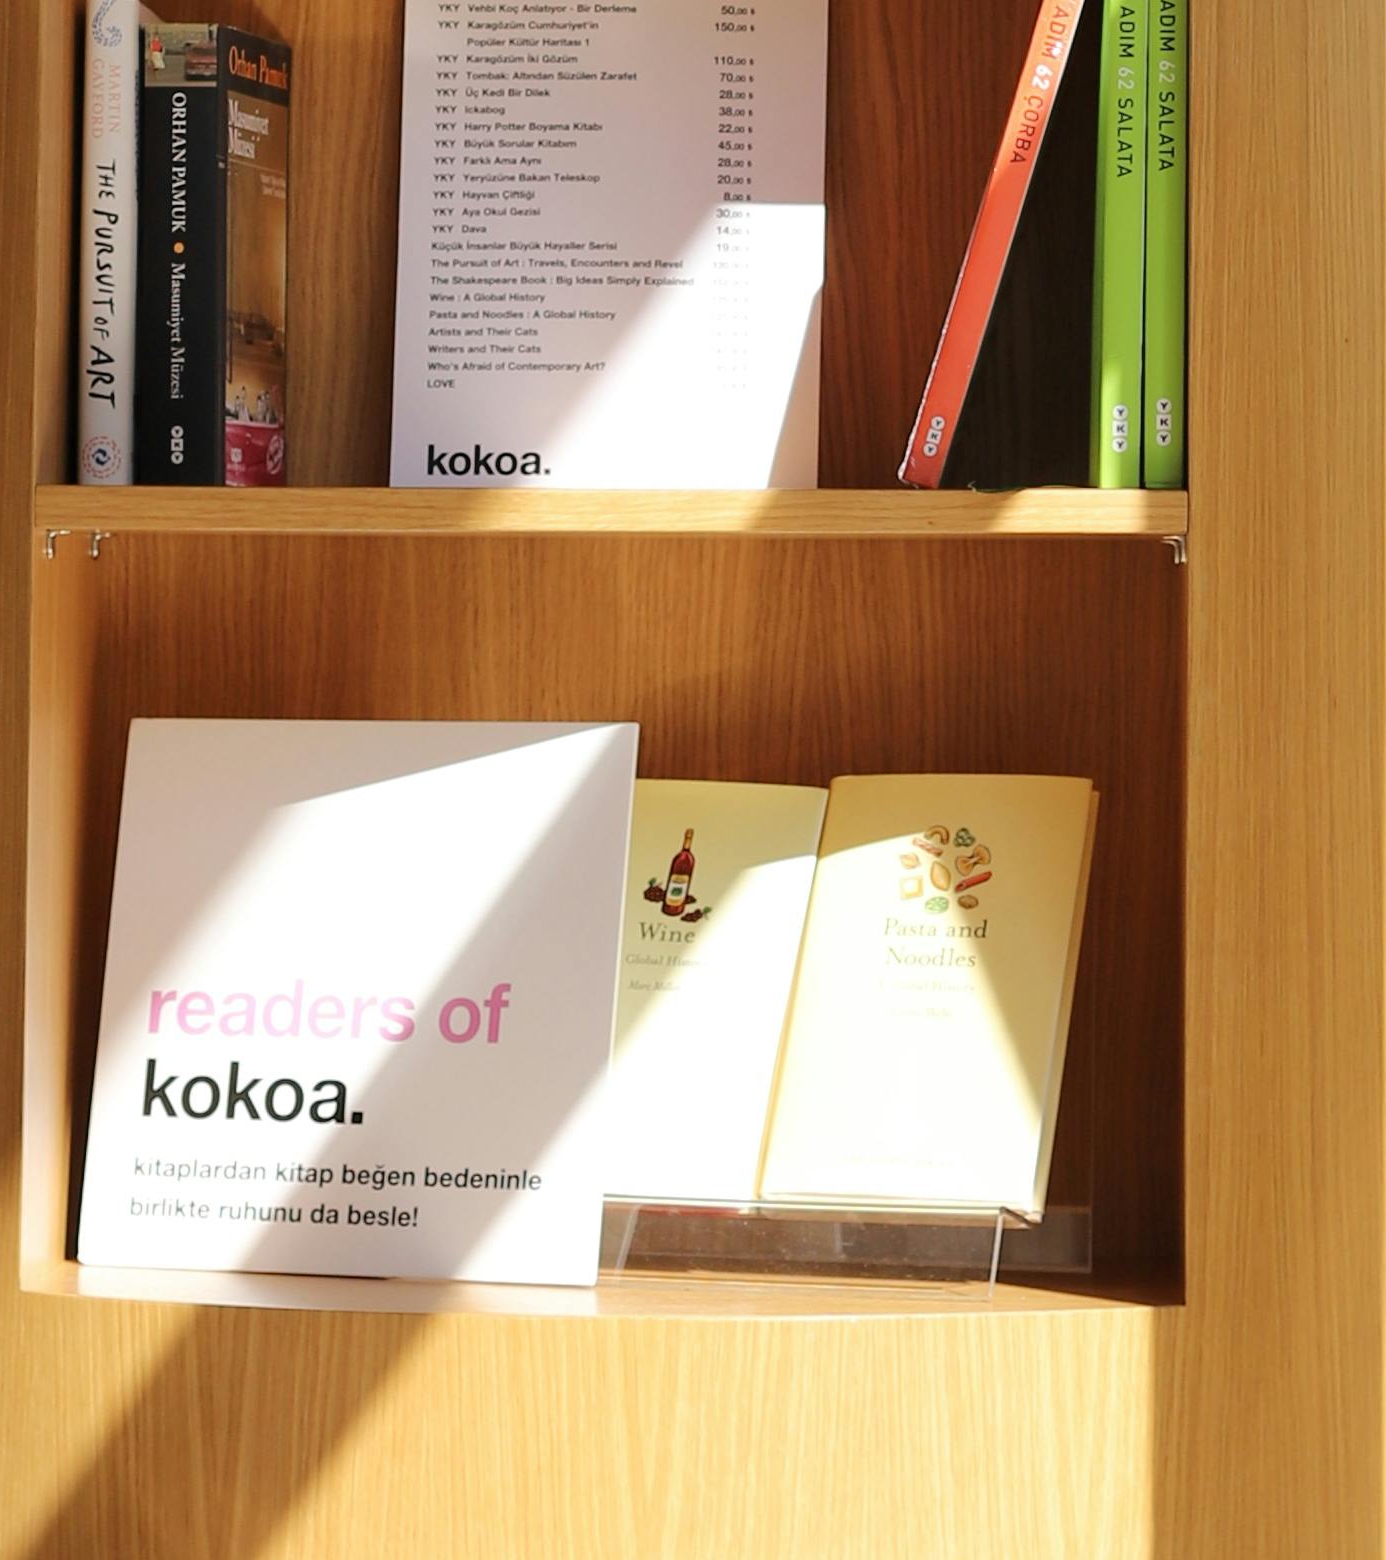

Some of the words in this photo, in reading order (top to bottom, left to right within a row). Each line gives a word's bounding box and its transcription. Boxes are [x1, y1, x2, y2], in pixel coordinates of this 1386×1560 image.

[1120, 5, 1135, 59] ADIM
[1031, 62, 1052, 94] 62
[1118, 65, 1134, 91] 62
[1159, 58, 1175, 84] 62
[171, 92, 187, 162] ORHAN
[1008, 95, 1045, 167] ÇORBA
[1116, 96, 1134, 179] SALATA
[1157, 90, 1175, 172] SALATA
[94, 159, 116, 199] THE
[171, 166, 187, 232] PAMUK
[92, 209, 119, 315] PURSUIT
[93, 317, 111, 341] OF
[166, 262, 186, 343] Masumiyet
[86, 345, 116, 410] ART
[169, 346, 186, 400] Müzesi
[427, 445, 550, 475] kokoa.
[639, 920, 696, 944] Wine
[883, 916, 937, 940] Pasta
[945, 917, 987, 940] and
[884, 946, 977, 968] Noodles
[146, 980, 417, 1042] readers
[438, 983, 512, 1044] of
[141, 1058, 365, 1125] kokoa.
[133, 1157, 266, 1183] kitaplardan
[275, 1161, 334, 1190] kitap
[341, 1164, 416, 1192] beğen
[424, 1166, 542, 1192] bedeninle
[129, 1197, 210, 1220] birlikte
[218, 1201, 302, 1225] ruhunu
[310, 1202, 339, 1226] da
[348, 1204, 419, 1228] besle!
